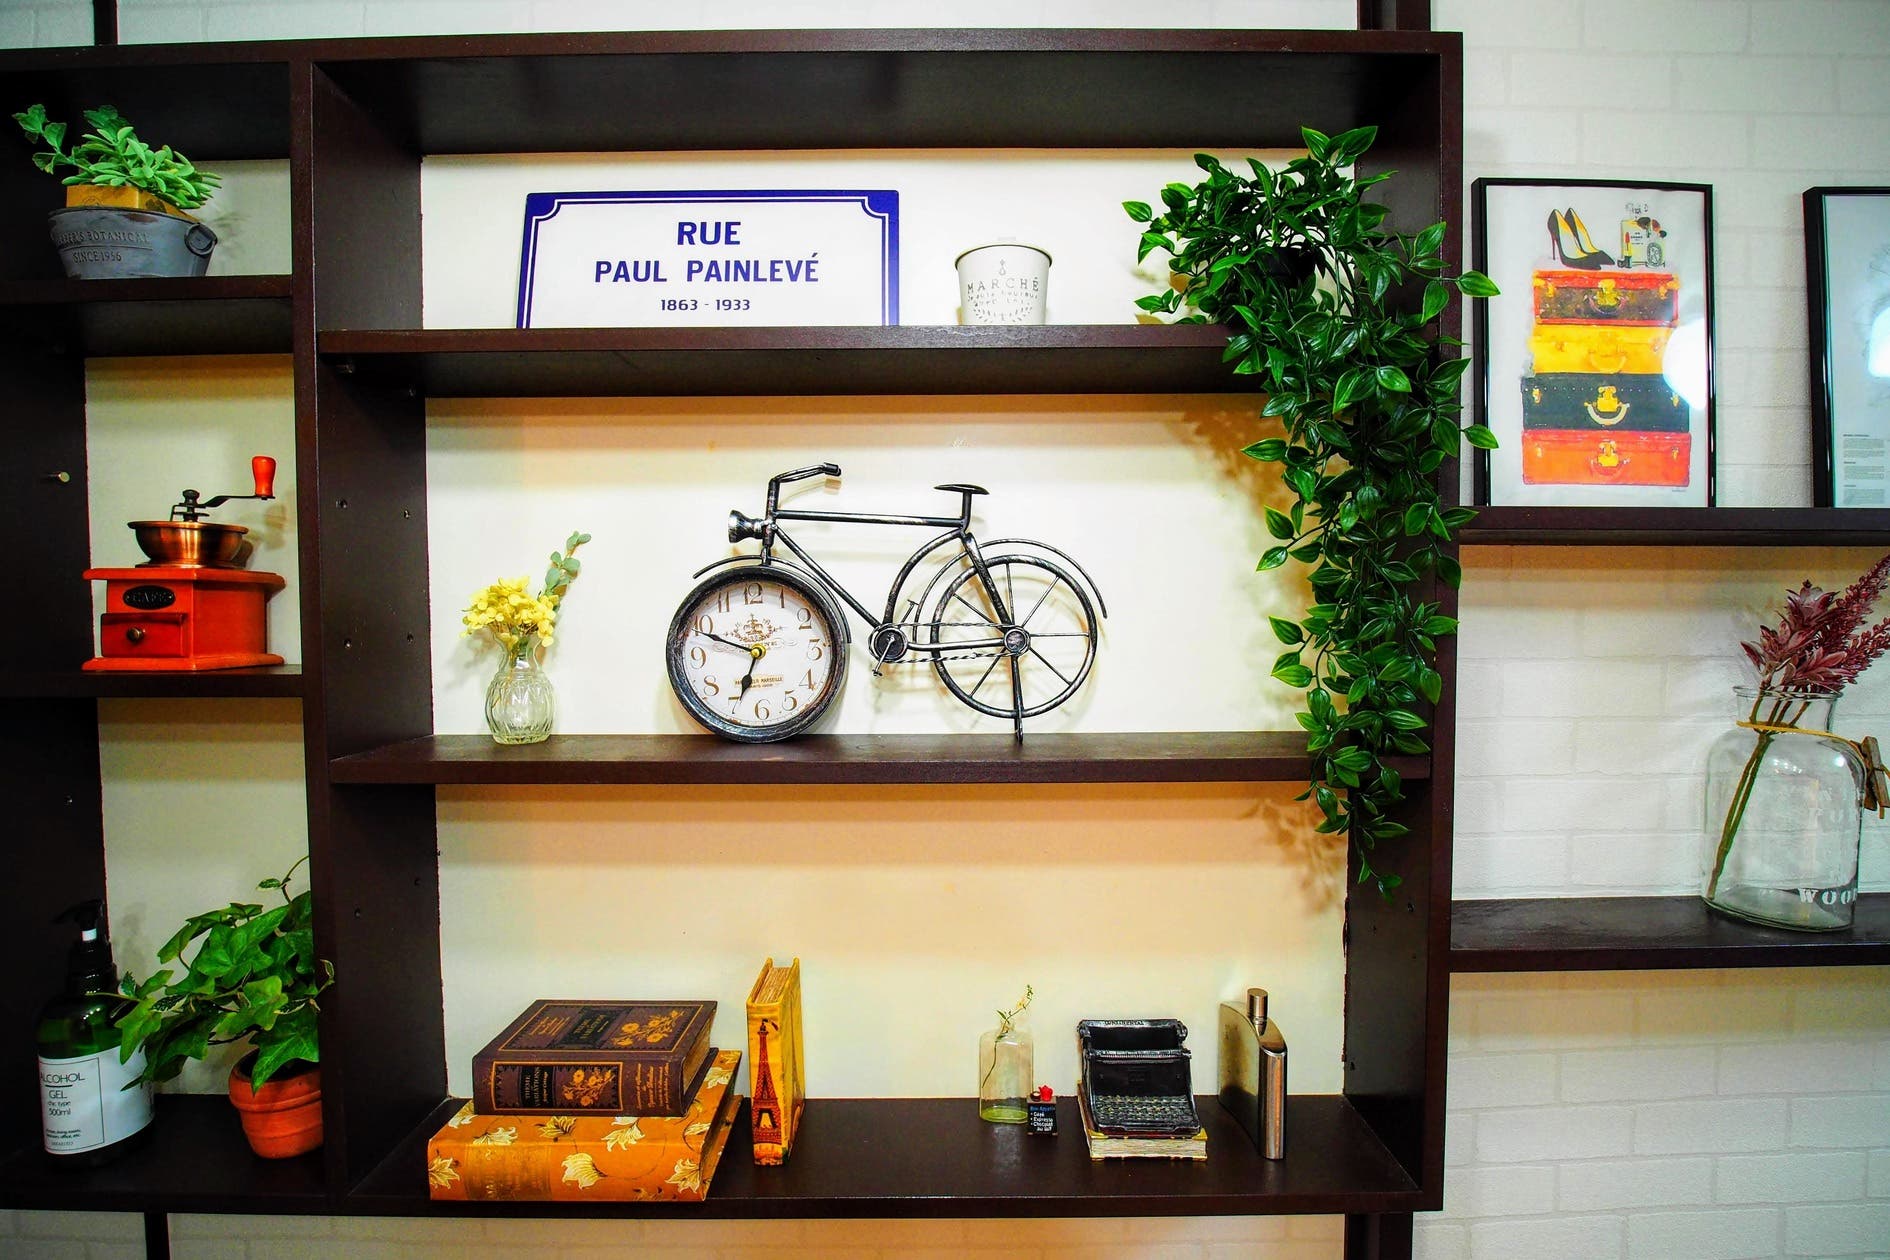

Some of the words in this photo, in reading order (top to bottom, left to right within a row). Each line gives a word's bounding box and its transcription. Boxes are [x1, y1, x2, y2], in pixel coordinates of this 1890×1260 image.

[677, 221, 741, 246] RUE
[72, 251, 99, 264] SINCE
[595, 260, 668, 283] PAUL
[687, 252, 820, 283] PAINLEVÉ
[967, 276, 1039, 295] MARCHÉ
[660, 299, 698, 311] 1863
[716, 299, 751, 311] 1933
[717, 591, 730, 614] 11
[743, 582, 763, 605] 12
[780, 586, 786, 609] 1
[693, 614, 714, 637] 10
[797, 607, 812, 630] 2
[690, 646, 707, 669] 9
[807, 638, 823, 661] 3
[703, 675, 720, 697] 8
[798, 668, 816, 691] 4
[728, 696, 741, 715] 7
[754, 699, 770, 721] 6
[782, 690, 798, 712] 5
[48, 1089, 68, 1099] GEL
[48, 1108, 71, 1116] 500ml
